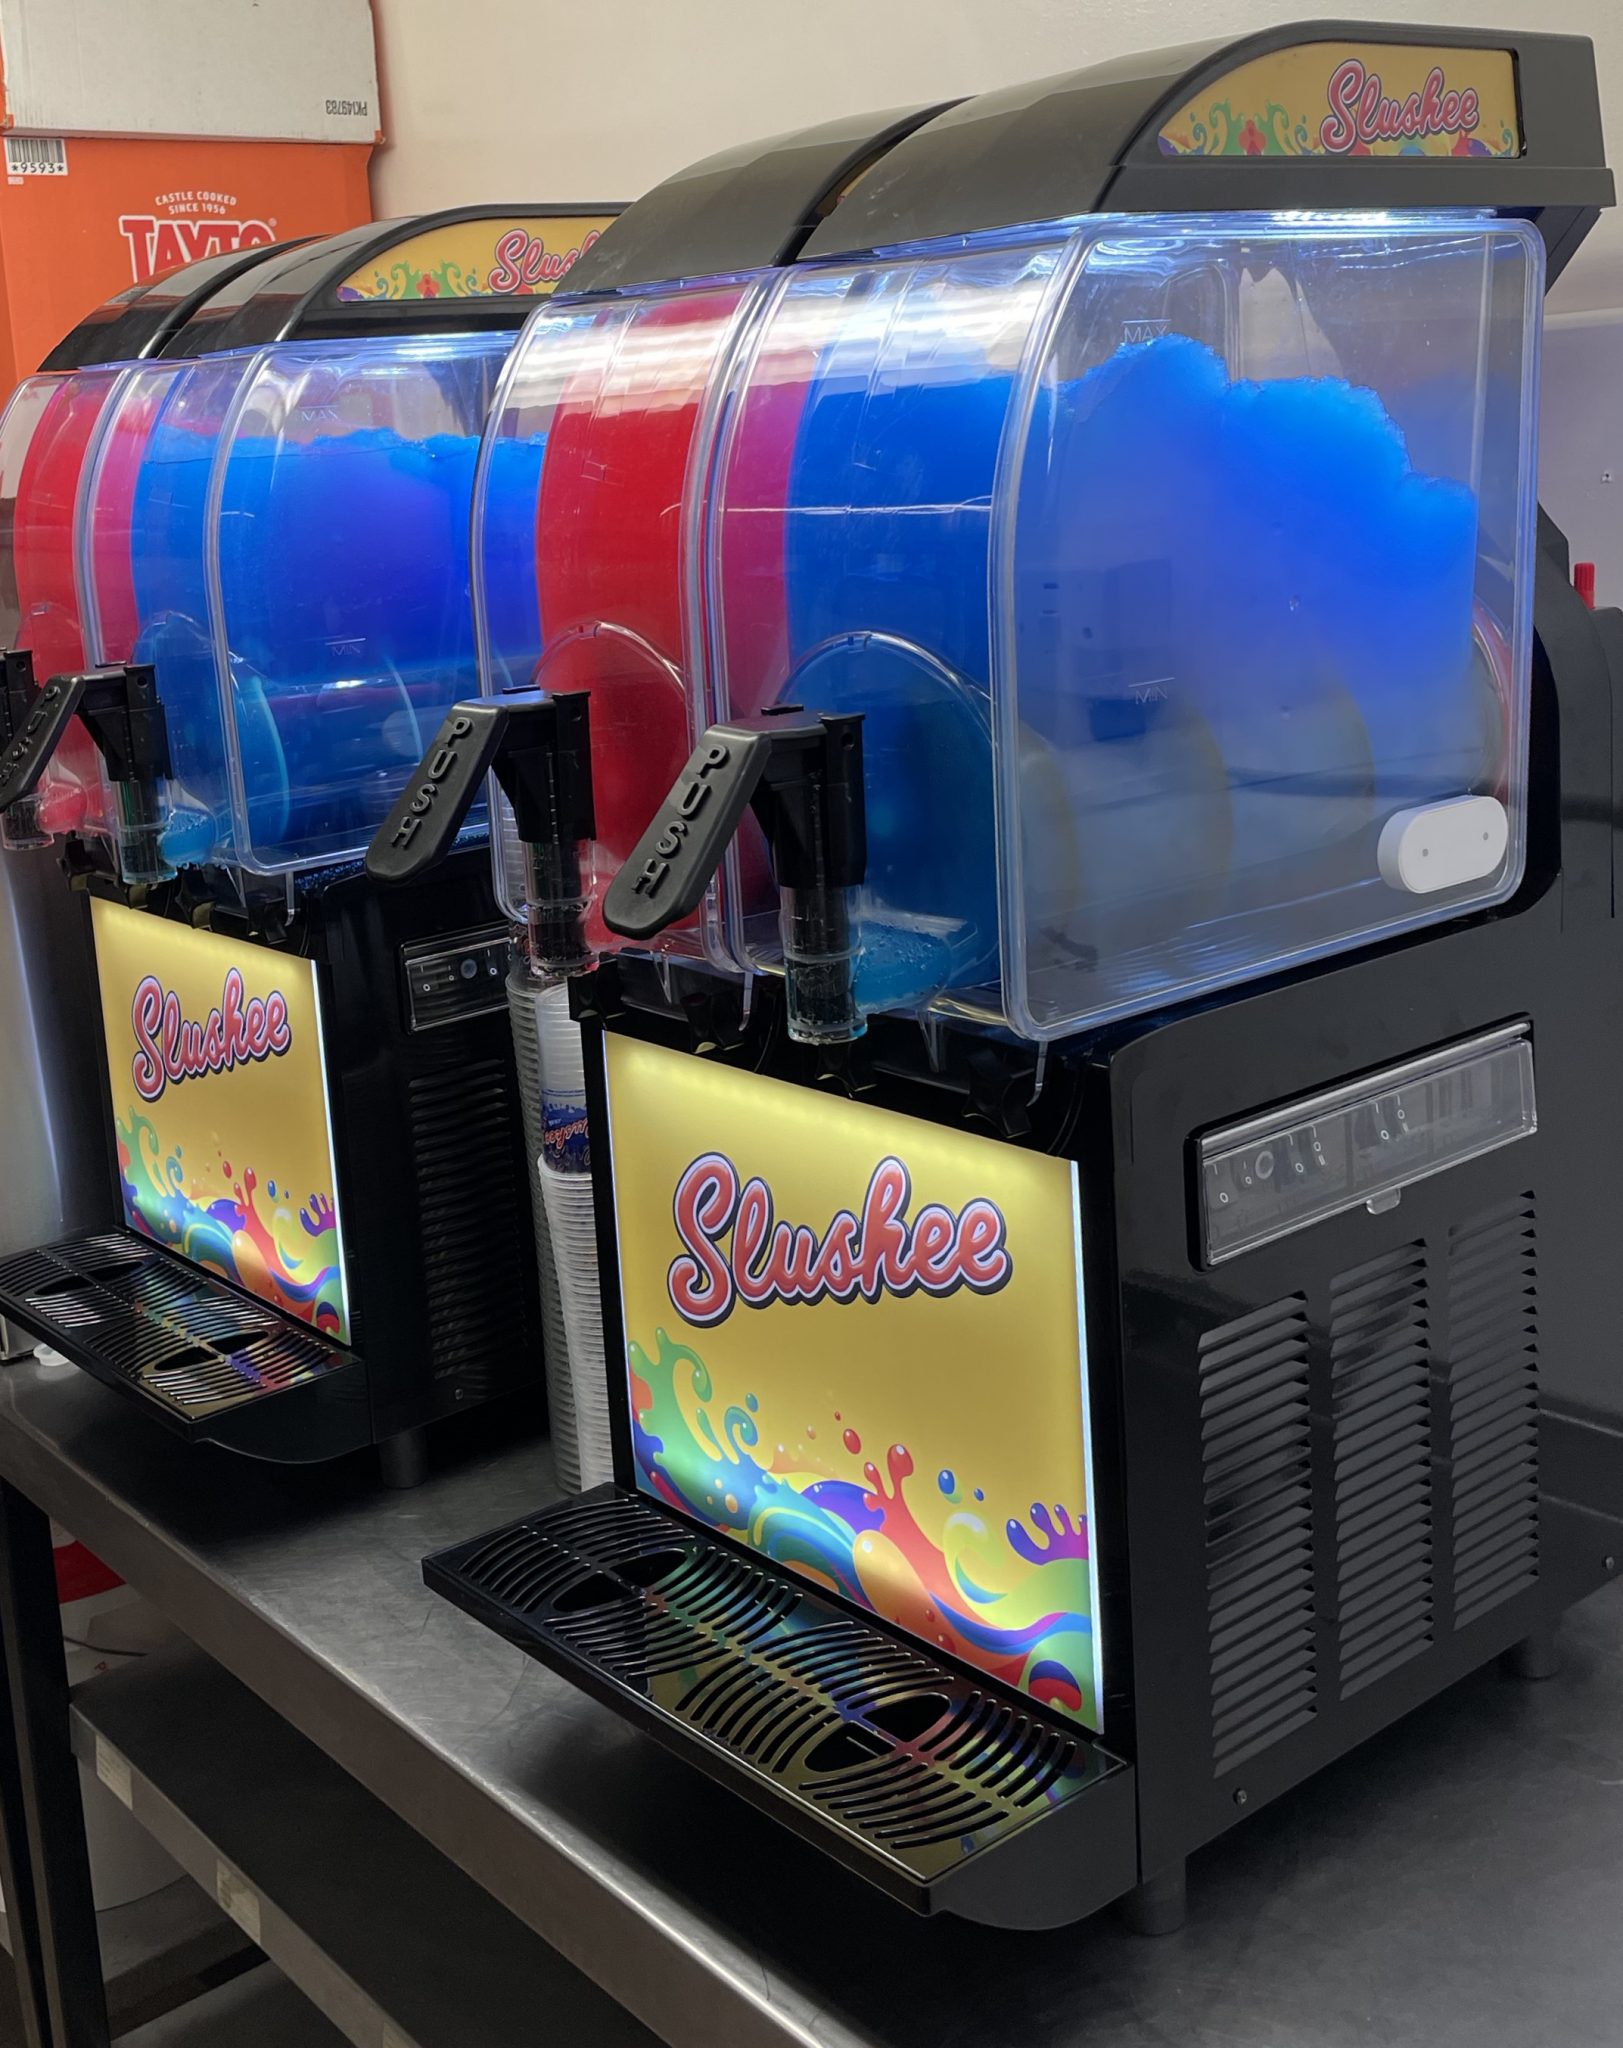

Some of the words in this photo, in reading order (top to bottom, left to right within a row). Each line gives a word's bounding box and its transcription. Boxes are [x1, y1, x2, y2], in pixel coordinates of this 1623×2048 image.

[1320, 58, 1479, 154] Slushee
[155, 191, 194, 206] CASTLE
[196, 191, 237, 206] COOKED
[168, 202, 199, 215] SINCE
[202, 202, 226, 215] 1956
[389, 717, 474, 849] PUSH
[631, 744, 730, 898] PUSH
[132, 967, 293, 1103] Slushee
[667, 1151, 1013, 1328] Slushee
